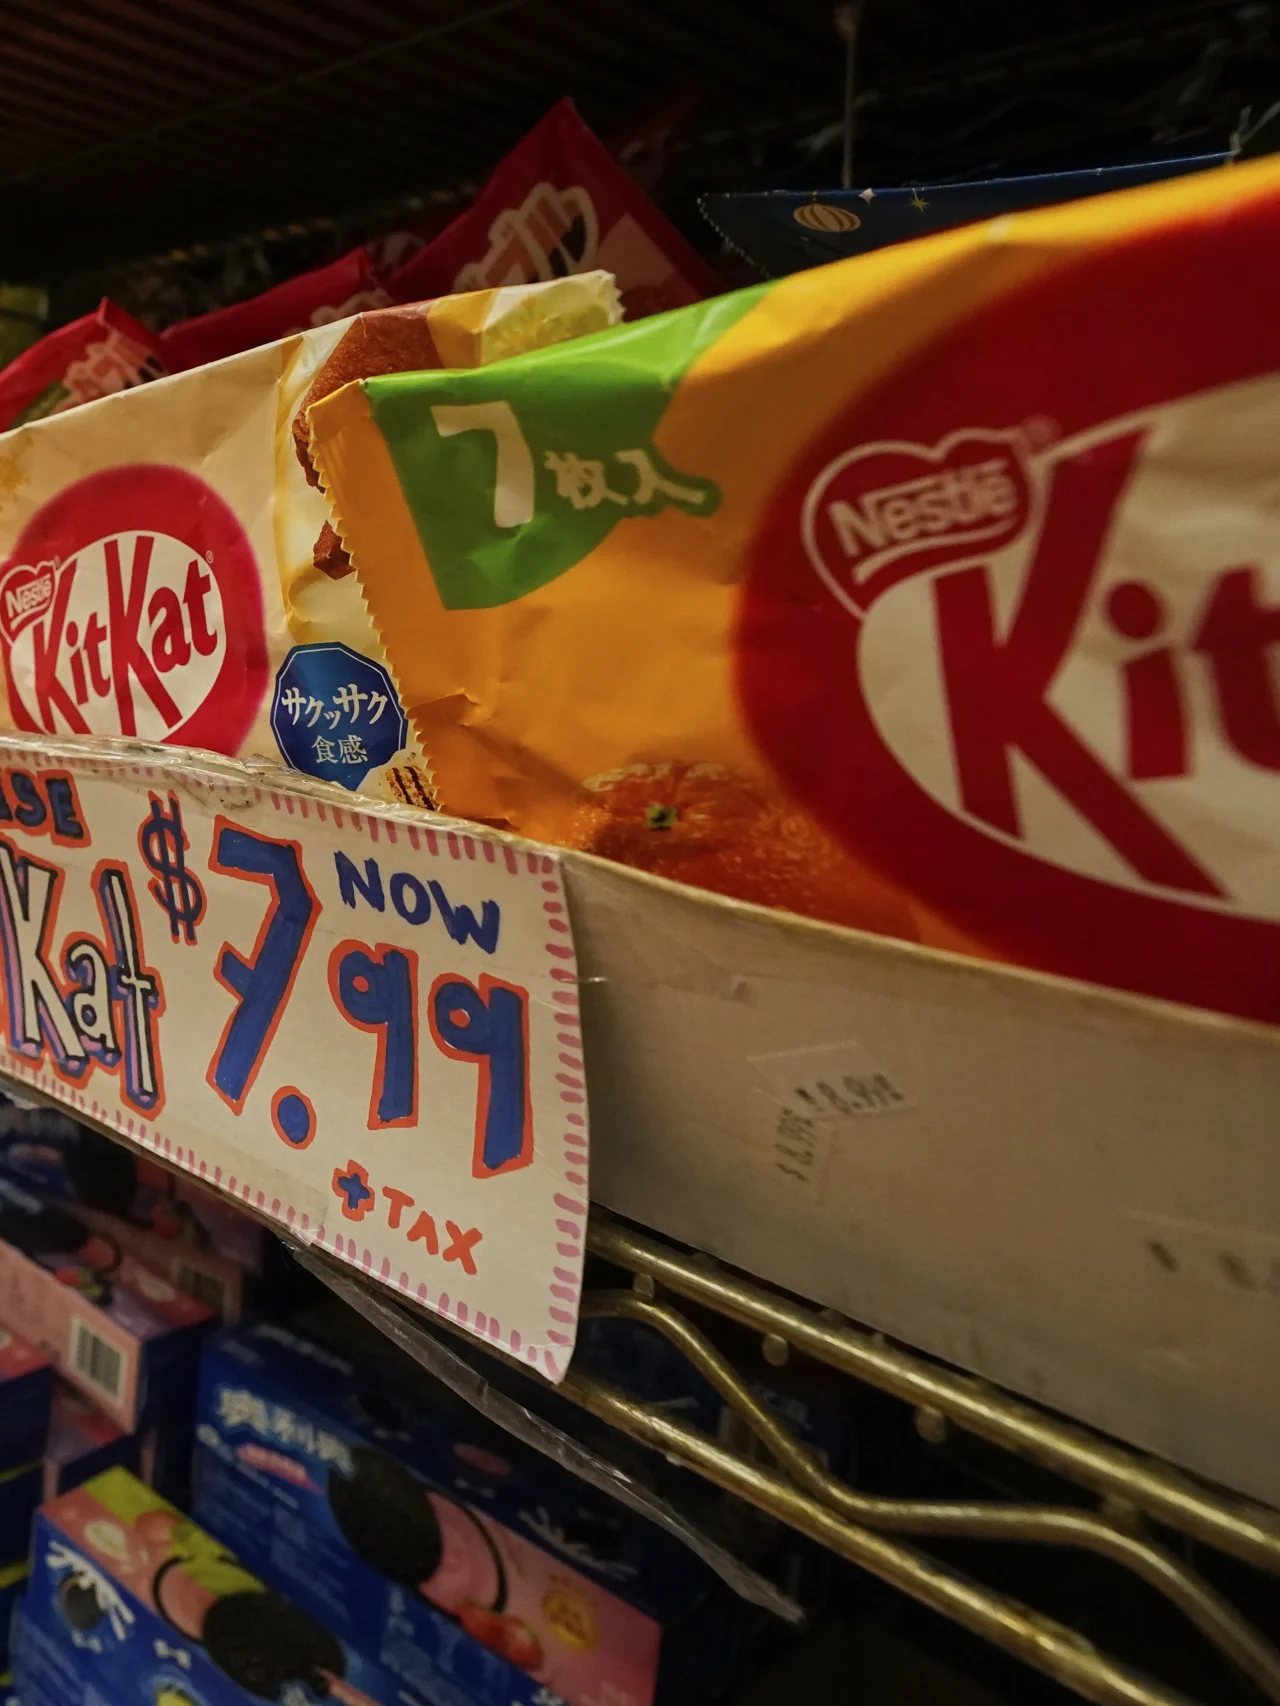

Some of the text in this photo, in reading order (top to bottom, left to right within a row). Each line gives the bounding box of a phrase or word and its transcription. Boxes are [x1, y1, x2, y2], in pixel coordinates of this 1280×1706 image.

[32, 535, 218, 737] KitKat
[281, 683, 388, 730] サクッサク
[311, 734, 368, 764] 食感
[334, 850, 501, 954] NOW
